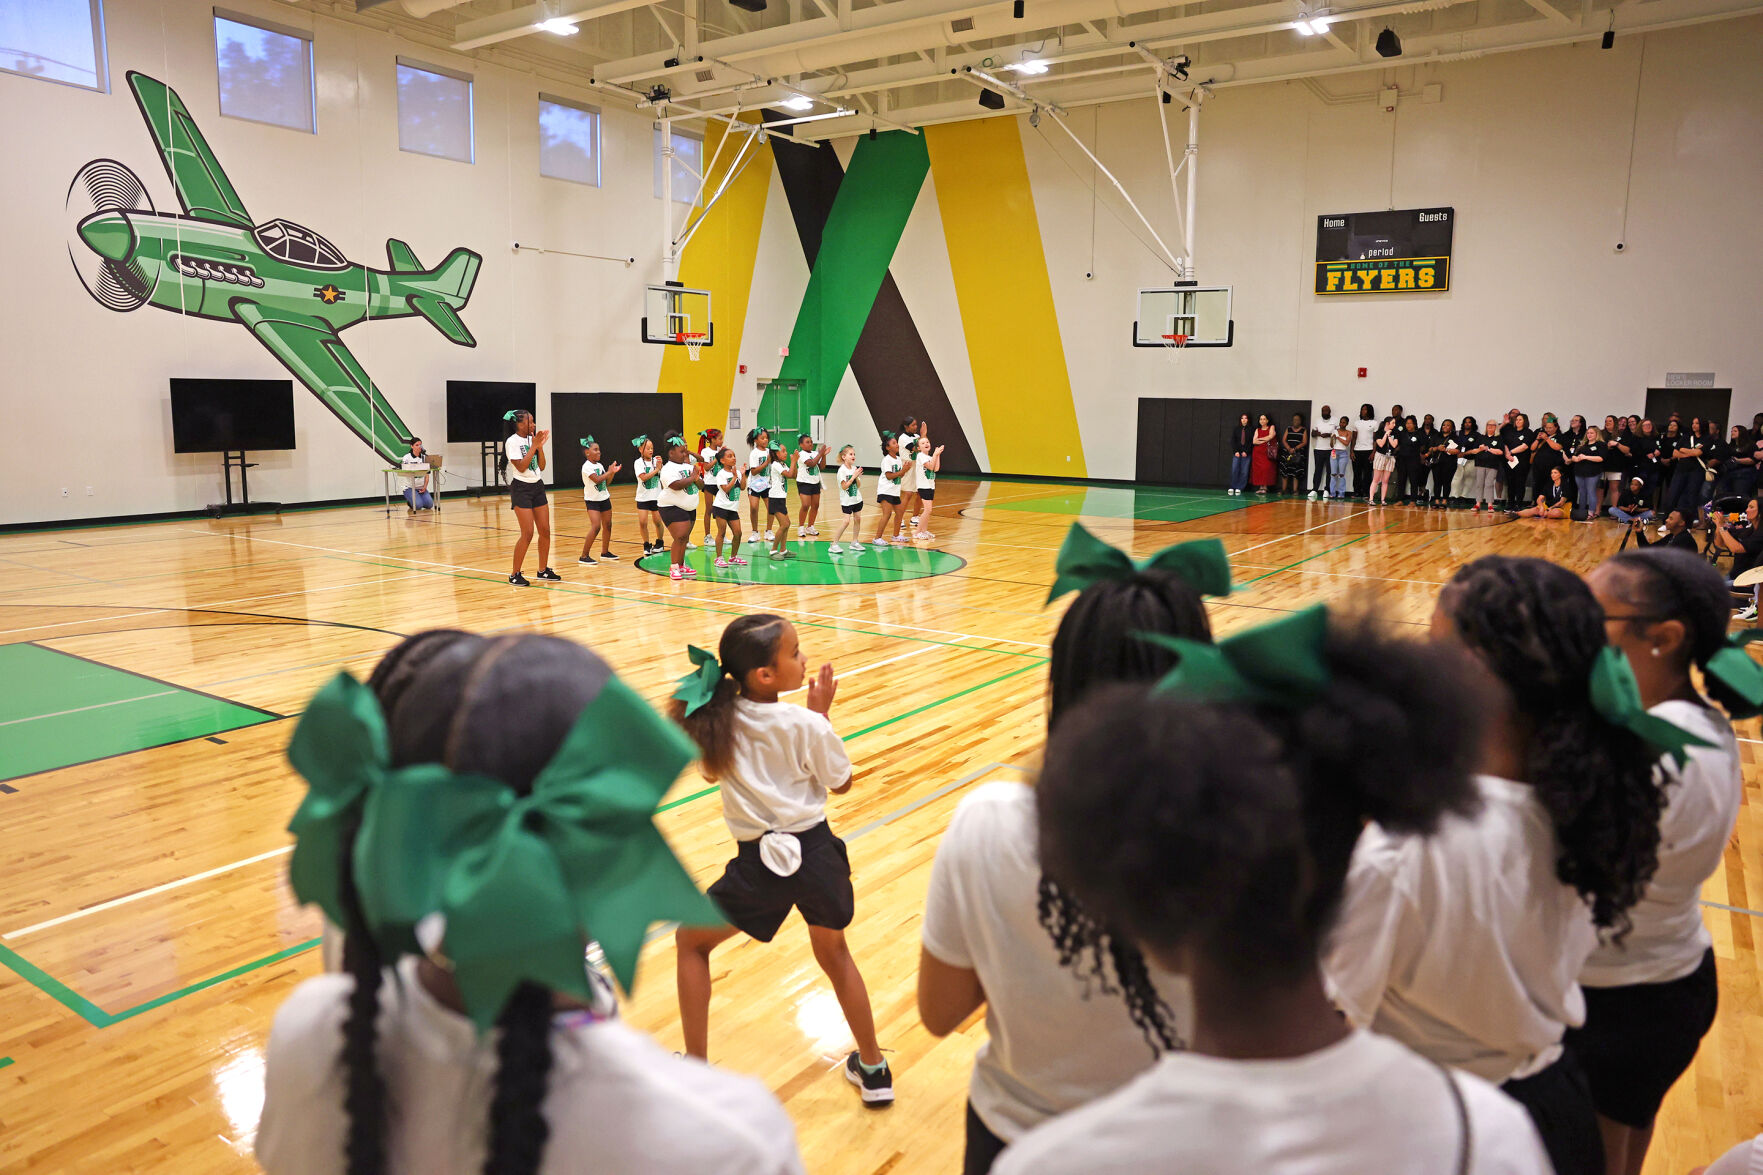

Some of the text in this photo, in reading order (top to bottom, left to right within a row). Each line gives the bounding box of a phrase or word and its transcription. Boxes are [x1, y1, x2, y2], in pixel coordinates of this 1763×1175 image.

[1419, 212, 1448, 222] Guests
[1324, 218, 1345, 228] Home
[1368, 247, 1394, 258] period
[1326, 268, 1435, 291] FLYERS
